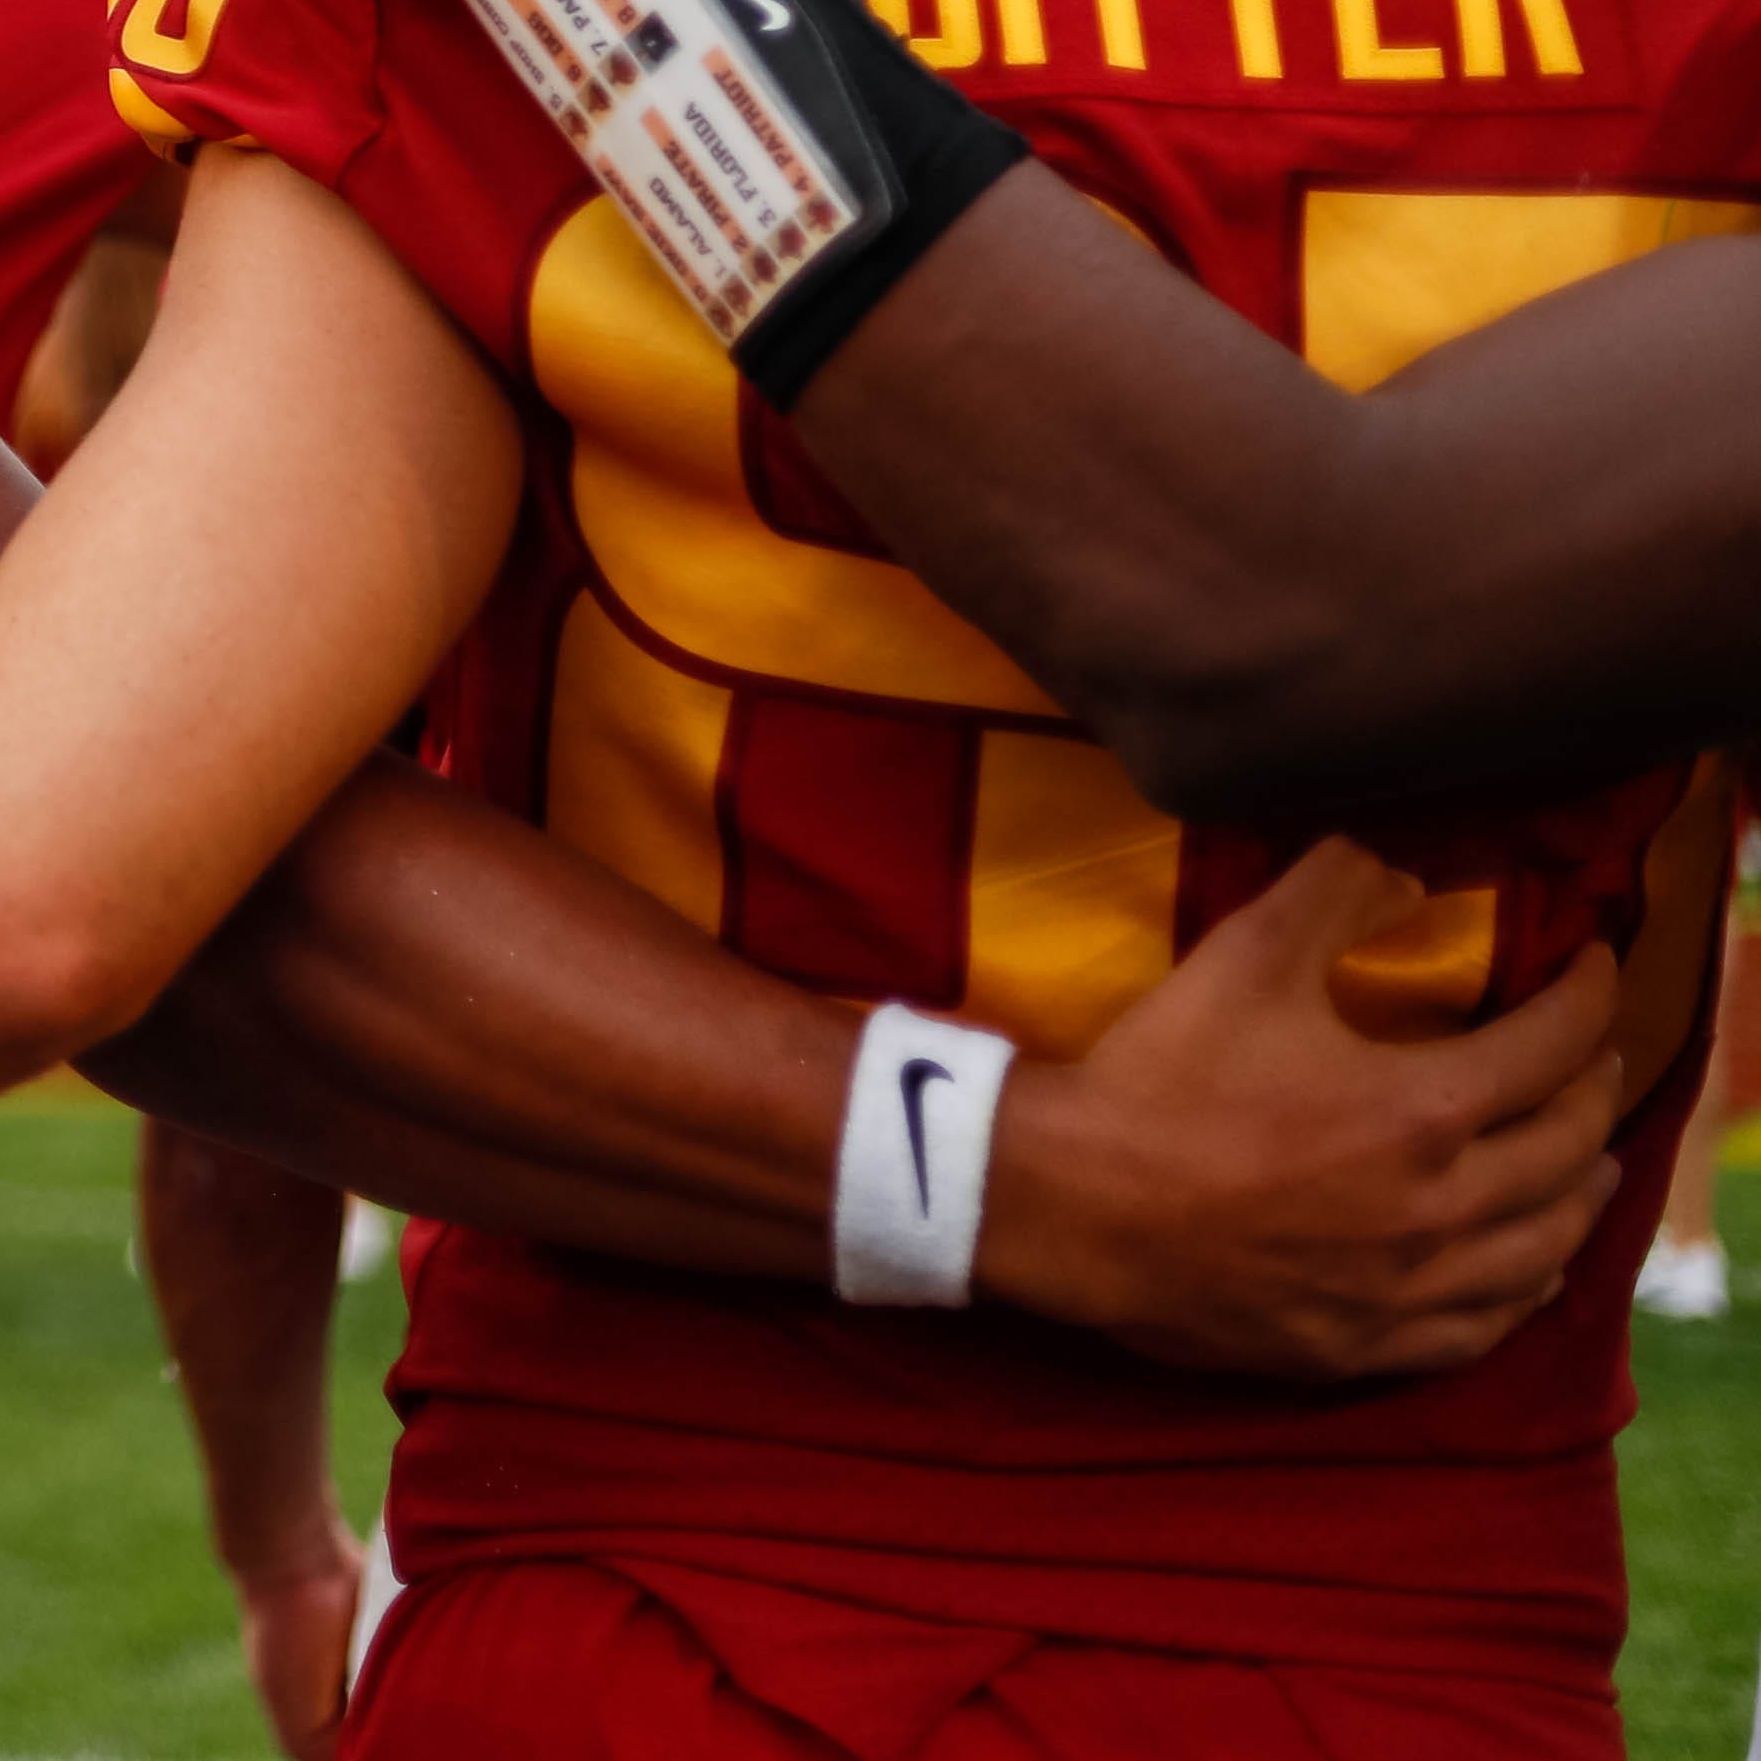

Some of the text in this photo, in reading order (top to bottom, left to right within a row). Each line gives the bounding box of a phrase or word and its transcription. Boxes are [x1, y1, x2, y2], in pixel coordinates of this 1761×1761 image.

[678, 100, 760, 203] FLORIDA
[710, 63, 796, 170] PATRIOT
[646, 174, 713, 259] ALAMO
[659, 138, 732, 229] PIRATE
